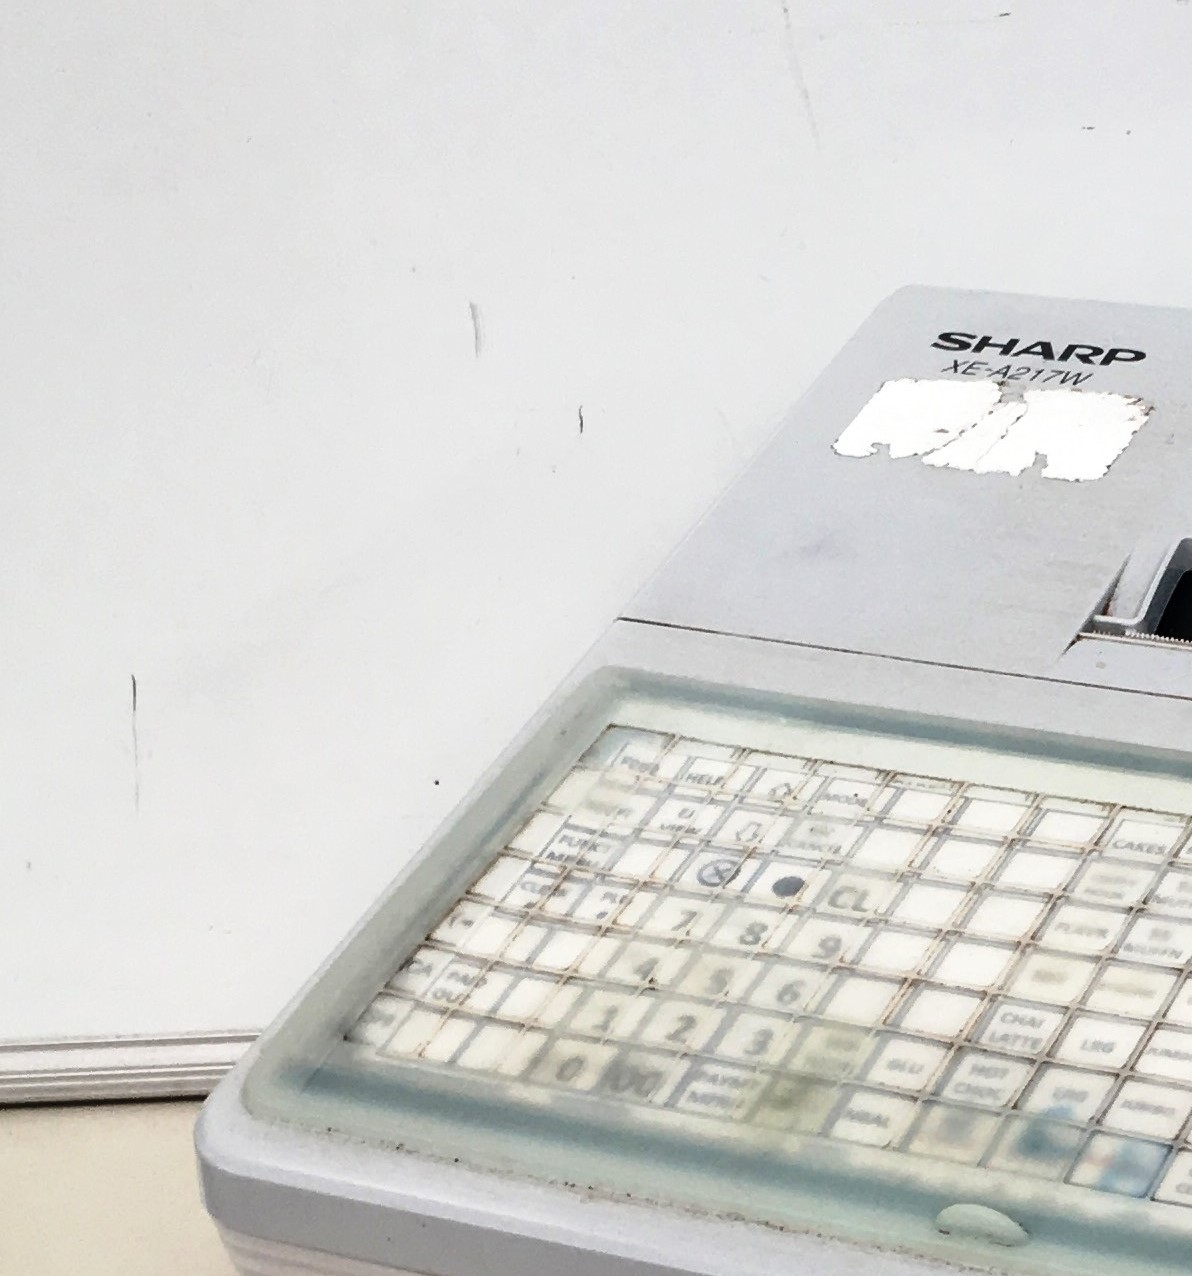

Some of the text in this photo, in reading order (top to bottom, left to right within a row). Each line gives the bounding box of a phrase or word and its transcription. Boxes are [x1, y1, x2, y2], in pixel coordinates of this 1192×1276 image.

[931, 332, 1147, 366] SHARP
[941, 359, 1094, 386] XE-A217W
[828, 885, 871, 913] CL
[672, 909, 698, 932] 7
[740, 922, 768, 945] 8
[813, 936, 842, 959] 9
[777, 980, 805, 1005] 6
[667, 1014, 697, 1042] 2
[747, 1028, 775, 1054] 3
